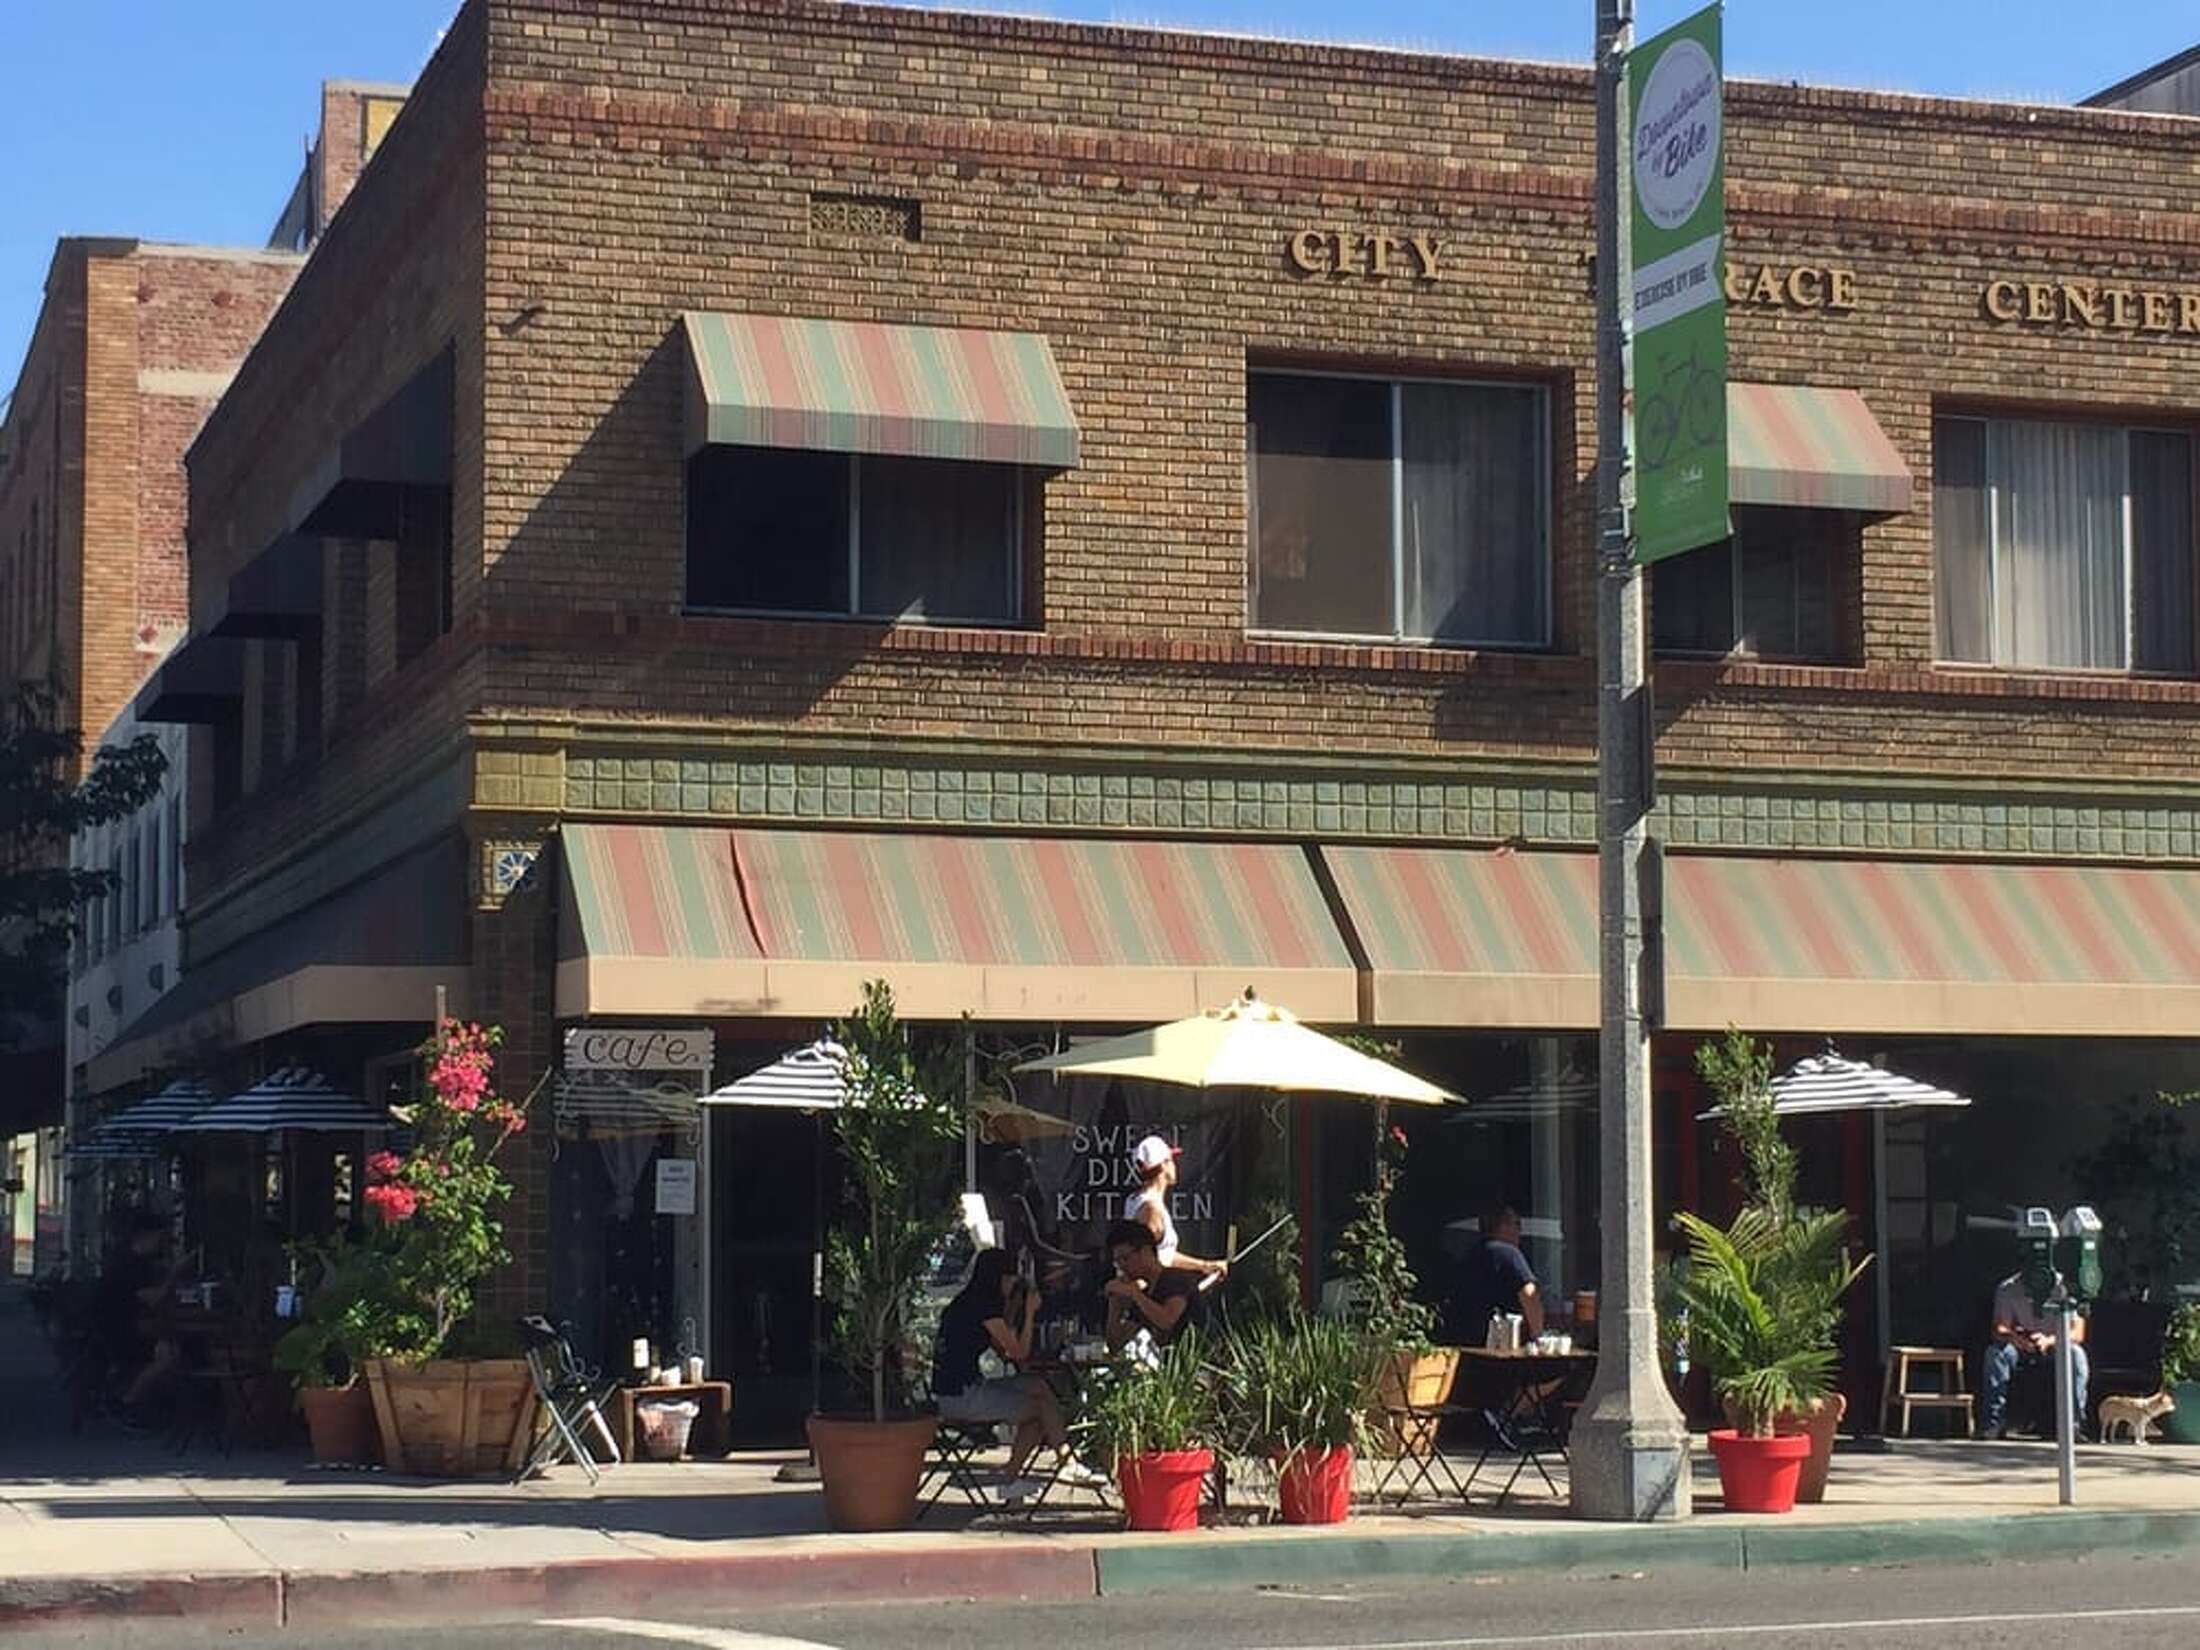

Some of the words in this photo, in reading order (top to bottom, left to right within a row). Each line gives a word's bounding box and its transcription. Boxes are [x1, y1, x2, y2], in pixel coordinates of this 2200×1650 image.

[1291, 229, 1448, 279] CITY
[1986, 277, 2200, 333] CENTER
[1072, 1124, 1188, 1153] SWET
[1087, 1158, 1145, 1186] DIX
[1056, 1192, 1213, 1222] KITEN
